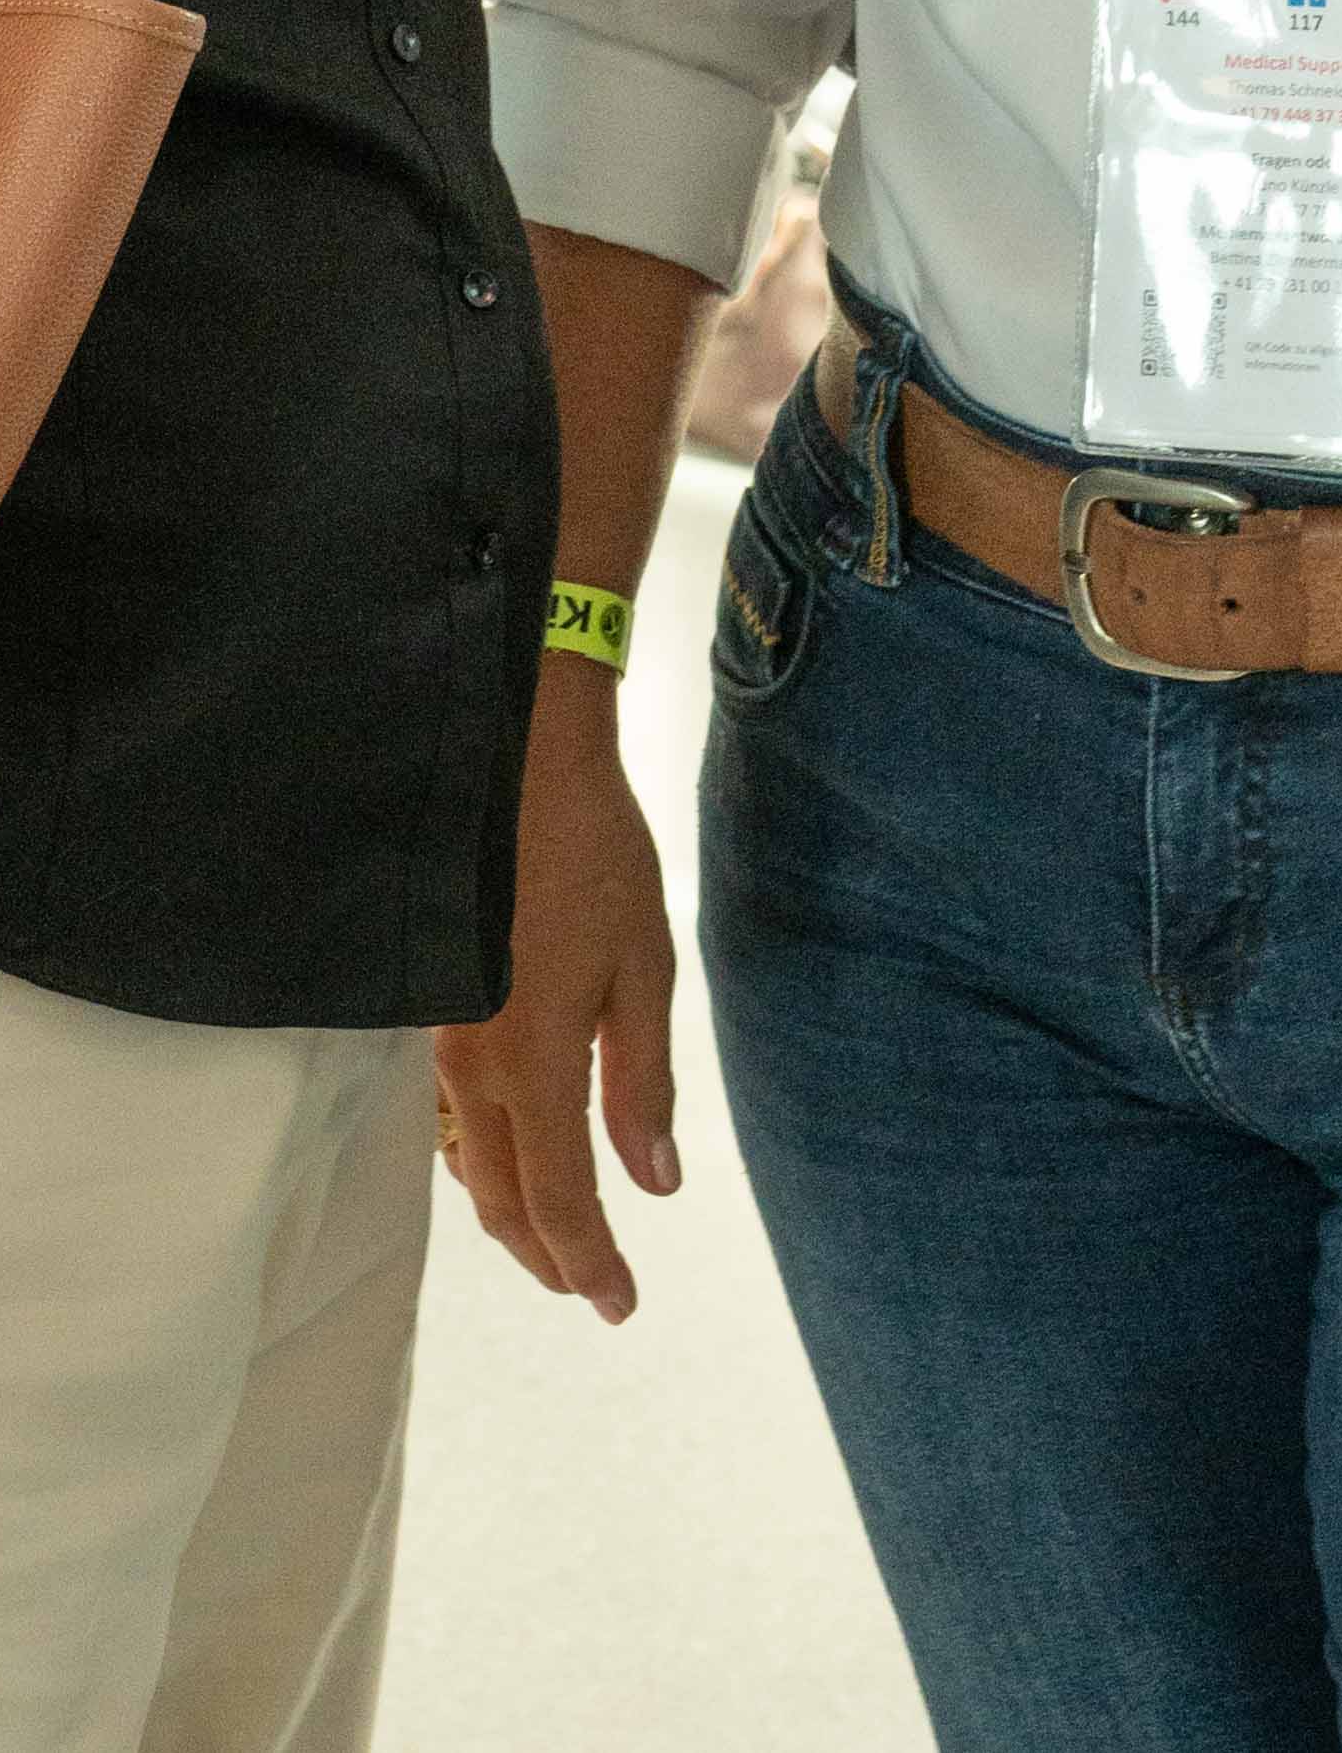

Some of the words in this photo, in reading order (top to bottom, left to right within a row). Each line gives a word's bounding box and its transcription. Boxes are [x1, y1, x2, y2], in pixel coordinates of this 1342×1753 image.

[1165, 10, 1200, 27] 144
[1289, 14, 1324, 31] 117
[1224, 54, 1293, 71] Medical
[1260, 107, 1280, 121] 79
[1315, 109, 1334, 123] 37
[1251, 152, 1302, 171] Fragen
